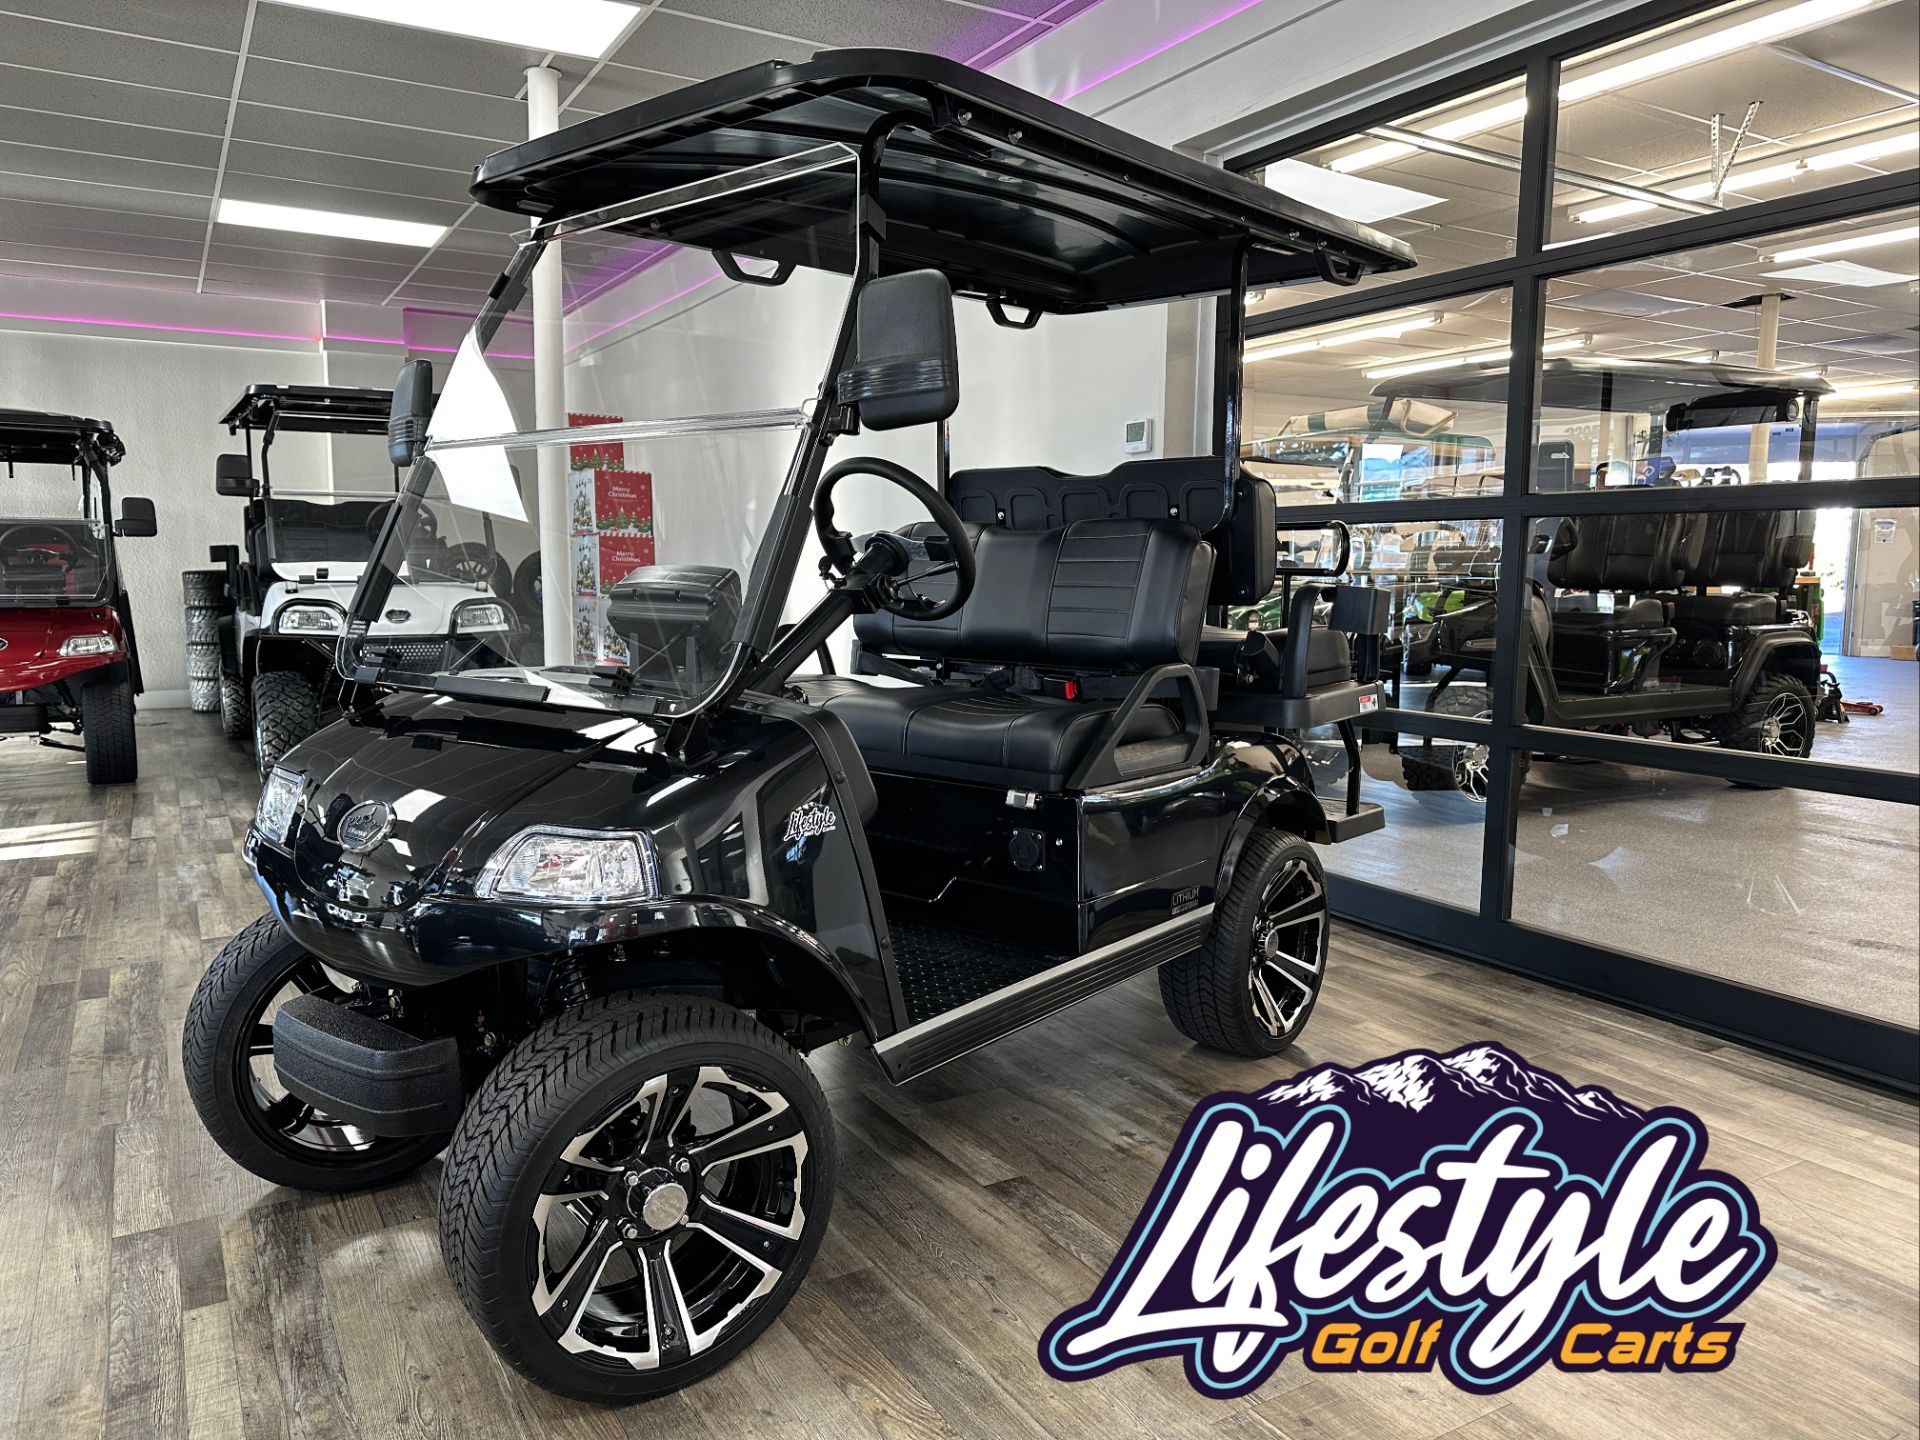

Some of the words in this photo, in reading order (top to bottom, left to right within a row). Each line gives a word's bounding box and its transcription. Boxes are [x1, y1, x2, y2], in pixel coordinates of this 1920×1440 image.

[608, 491, 637, 499] Christmas
[616, 550, 634, 558] Merry
[611, 555, 641, 563] Christmas
[784, 805, 836, 841] Lifestyle
[1172, 887, 1199, 906] LITHIUM
